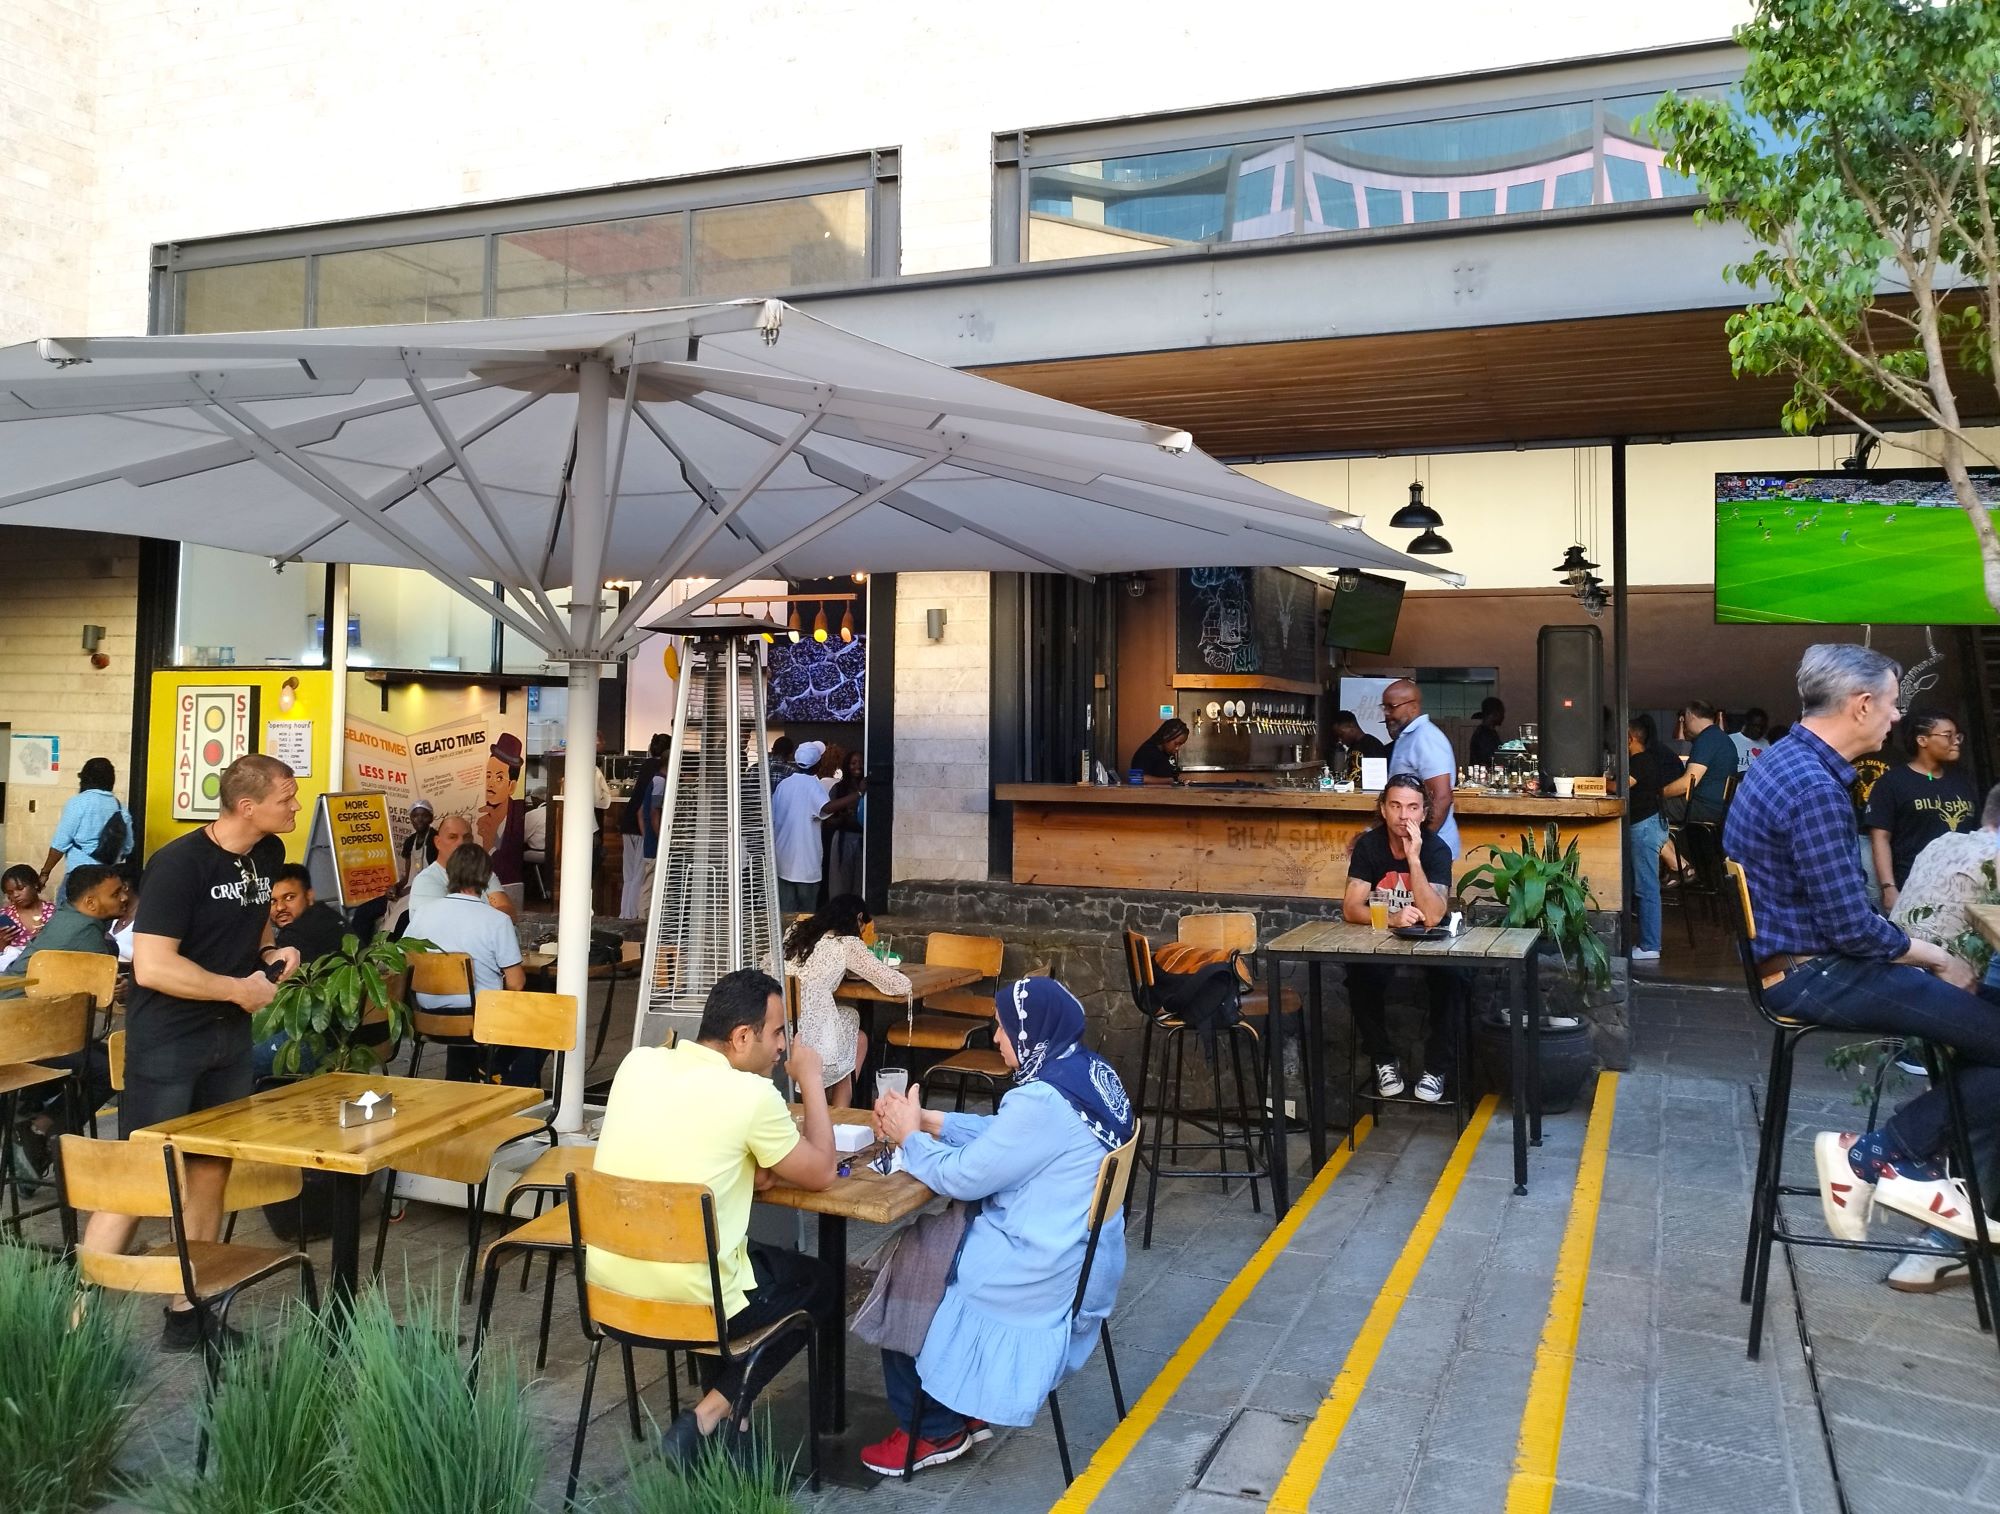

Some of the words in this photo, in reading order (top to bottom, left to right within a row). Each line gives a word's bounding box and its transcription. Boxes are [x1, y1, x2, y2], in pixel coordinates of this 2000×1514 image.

[1746, 479, 1752, 487] 0
[1760, 479, 1766, 487] 0
[235, 694, 247, 758] STR
[269, 722, 292, 730] opening
[293, 721, 311, 729] hours
[379, 738, 408, 757] TIMES
[414, 738, 456, 756] GELATO
[455, 730, 486, 749] TIMES
[177, 694, 194, 809] GELATO
[358, 763, 384, 780] LESS
[388, 770, 408, 785] FAT
[344, 800, 370, 810] MORE
[337, 811, 381, 822] ESPRESSO
[350, 823, 372, 833] LESS
[341, 833, 384, 846] DEPRESSO
[1226, 826, 1278, 850] BILA
[350, 867, 386, 878] GREAT
[348, 876, 391, 887] GELATO
